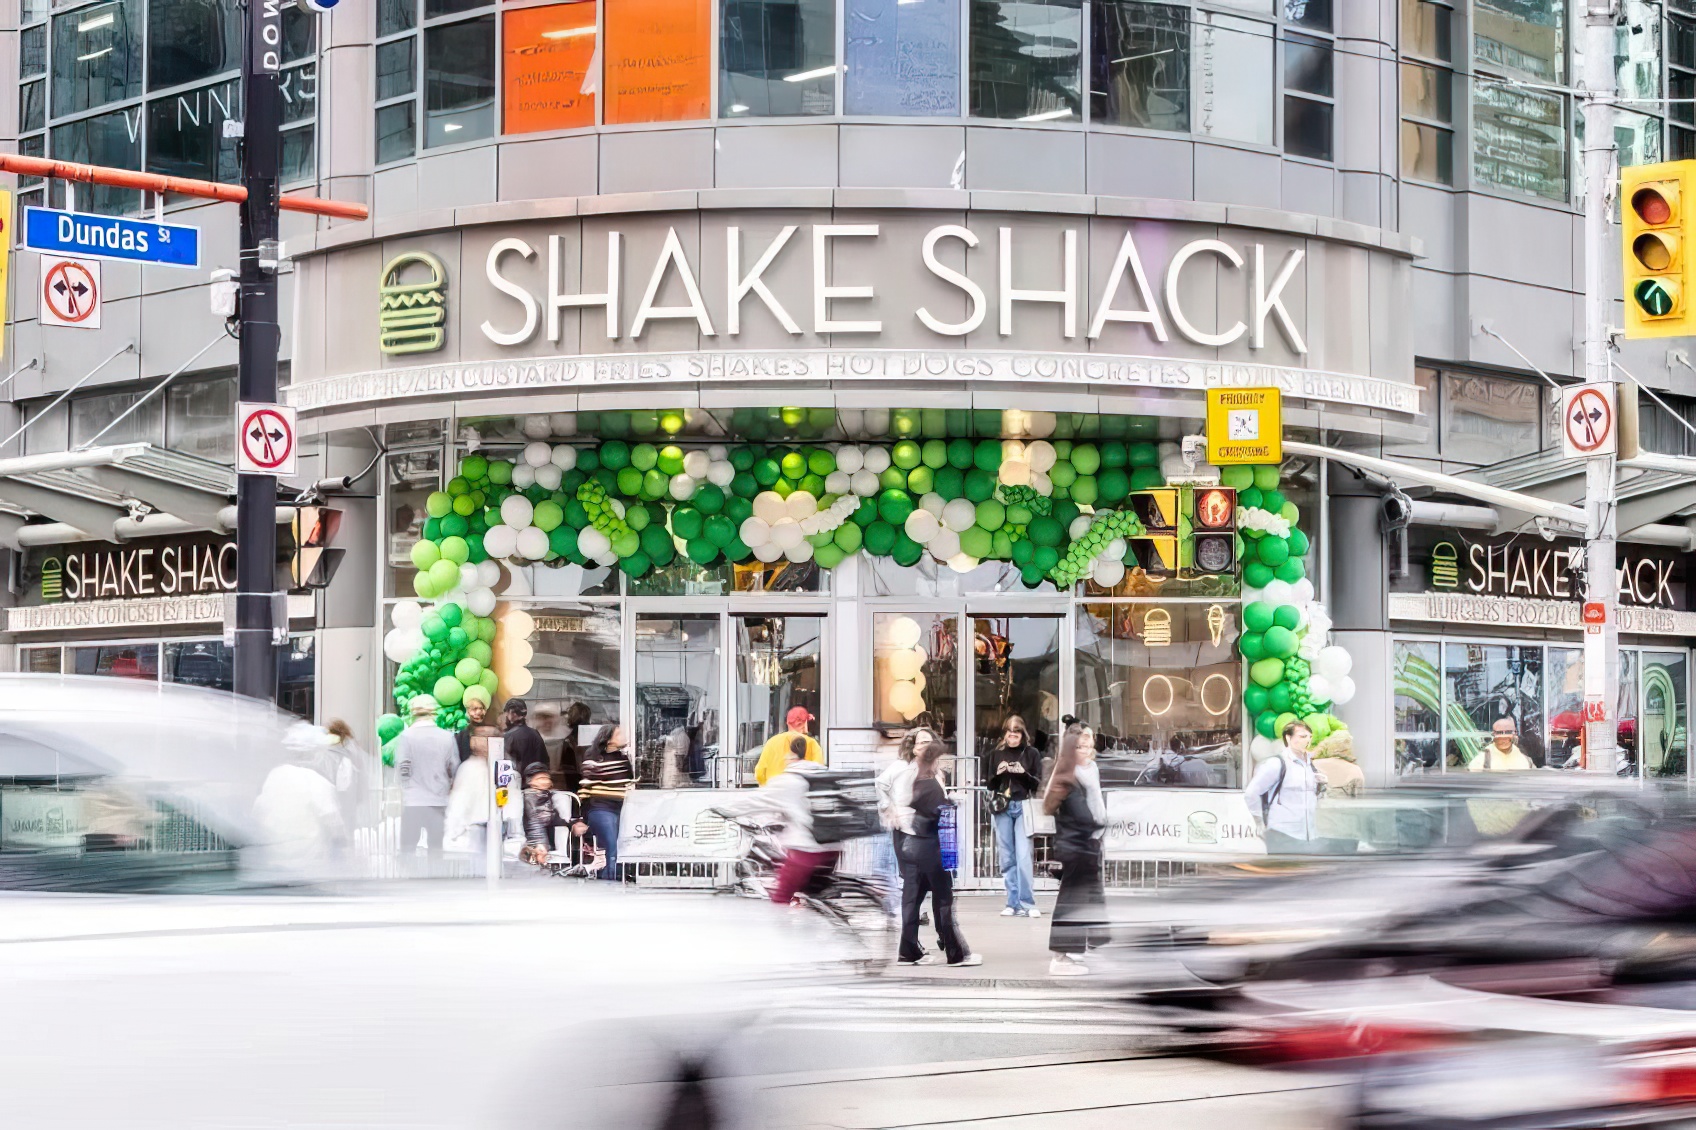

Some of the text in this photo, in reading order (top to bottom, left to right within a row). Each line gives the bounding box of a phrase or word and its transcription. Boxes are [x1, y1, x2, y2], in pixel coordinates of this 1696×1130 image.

[58, 215, 149, 252] Dundas
[481, 224, 1308, 354] SHAKE SHACK
[461, 361, 580, 388] CUSTARD
[593, 356, 672, 382] FRIES
[687, 354, 810, 378] SHAKES
[826, 353, 889, 377] HOT
[902, 353, 994, 377] DOGS
[1010, 357, 1191, 384] CONCRETES
[65, 542, 238, 599] SHAKE SHAC
[1467, 543, 1570, 598] SHAKE
[633, 824, 692, 839] SHAKE
